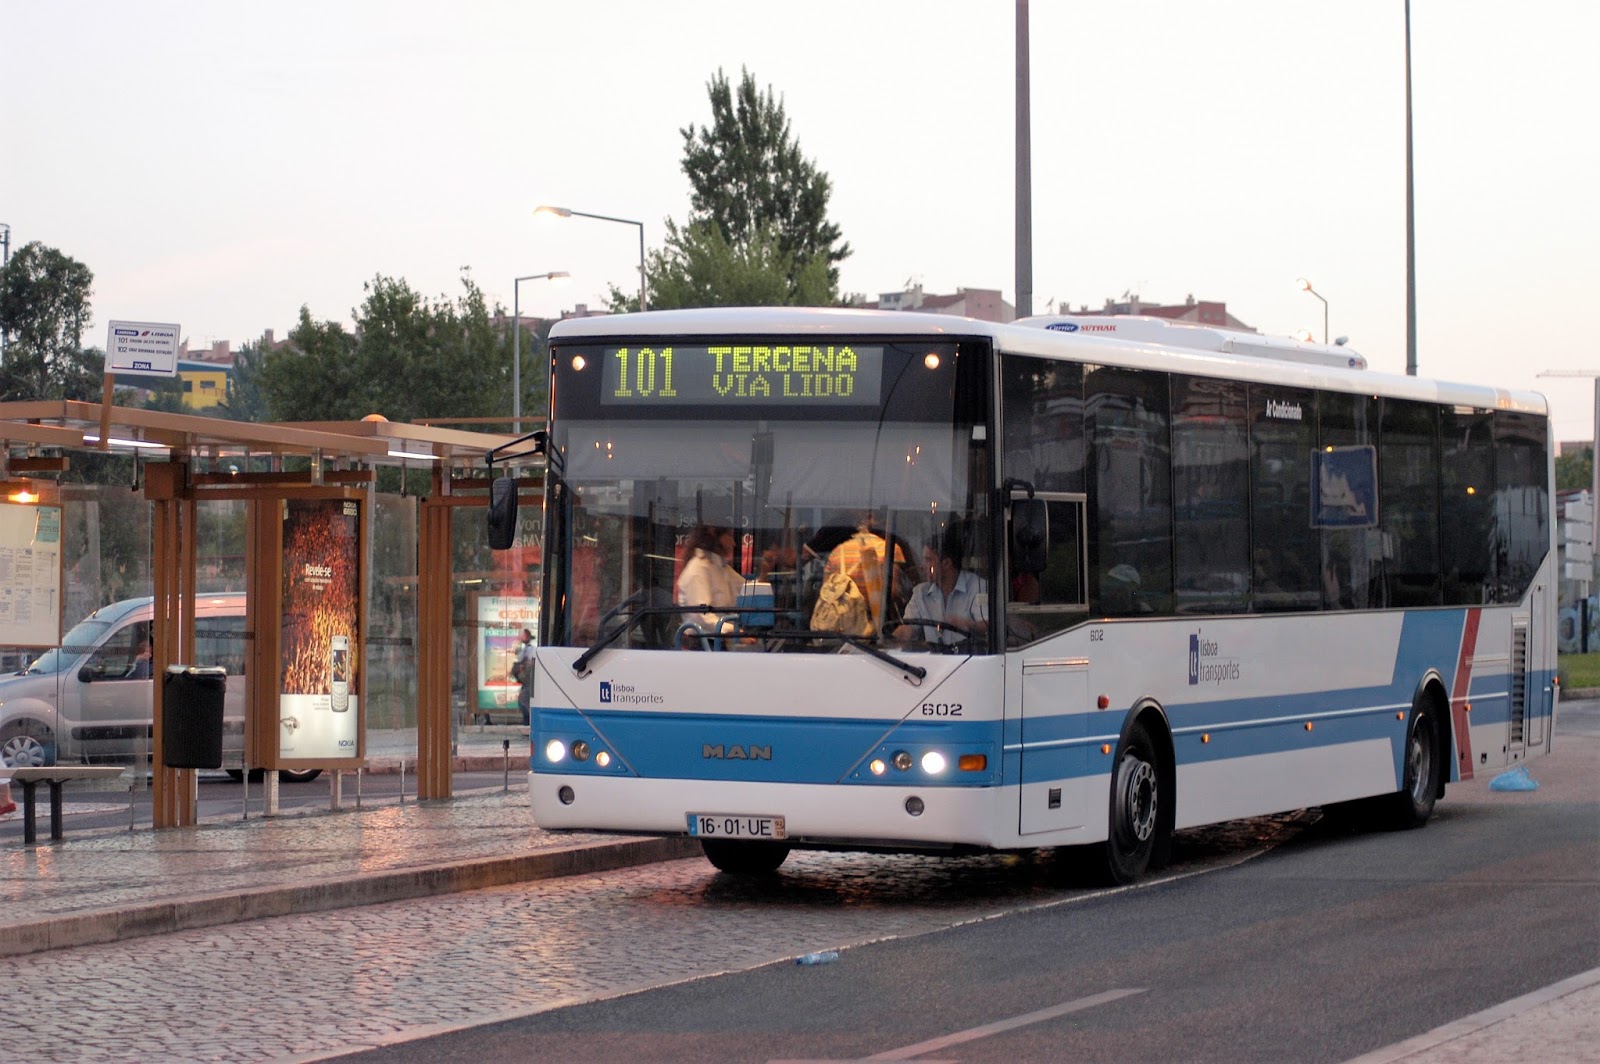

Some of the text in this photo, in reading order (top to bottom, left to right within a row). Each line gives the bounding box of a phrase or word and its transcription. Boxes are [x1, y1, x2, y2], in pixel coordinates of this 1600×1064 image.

[707, 346, 857, 372] TERCENA
[614, 347, 677, 397] 101
[713, 374, 854, 397] VIA LIDO
[1090, 629, 1104, 642] 602
[1200, 639, 1218, 656] lisboa
[1200, 659, 1240, 686] transportes
[613, 684, 635, 692] lisboa
[613, 693, 664, 704] transportes
[922, 703, 963, 716] 602
[703, 744, 772, 760] MAN
